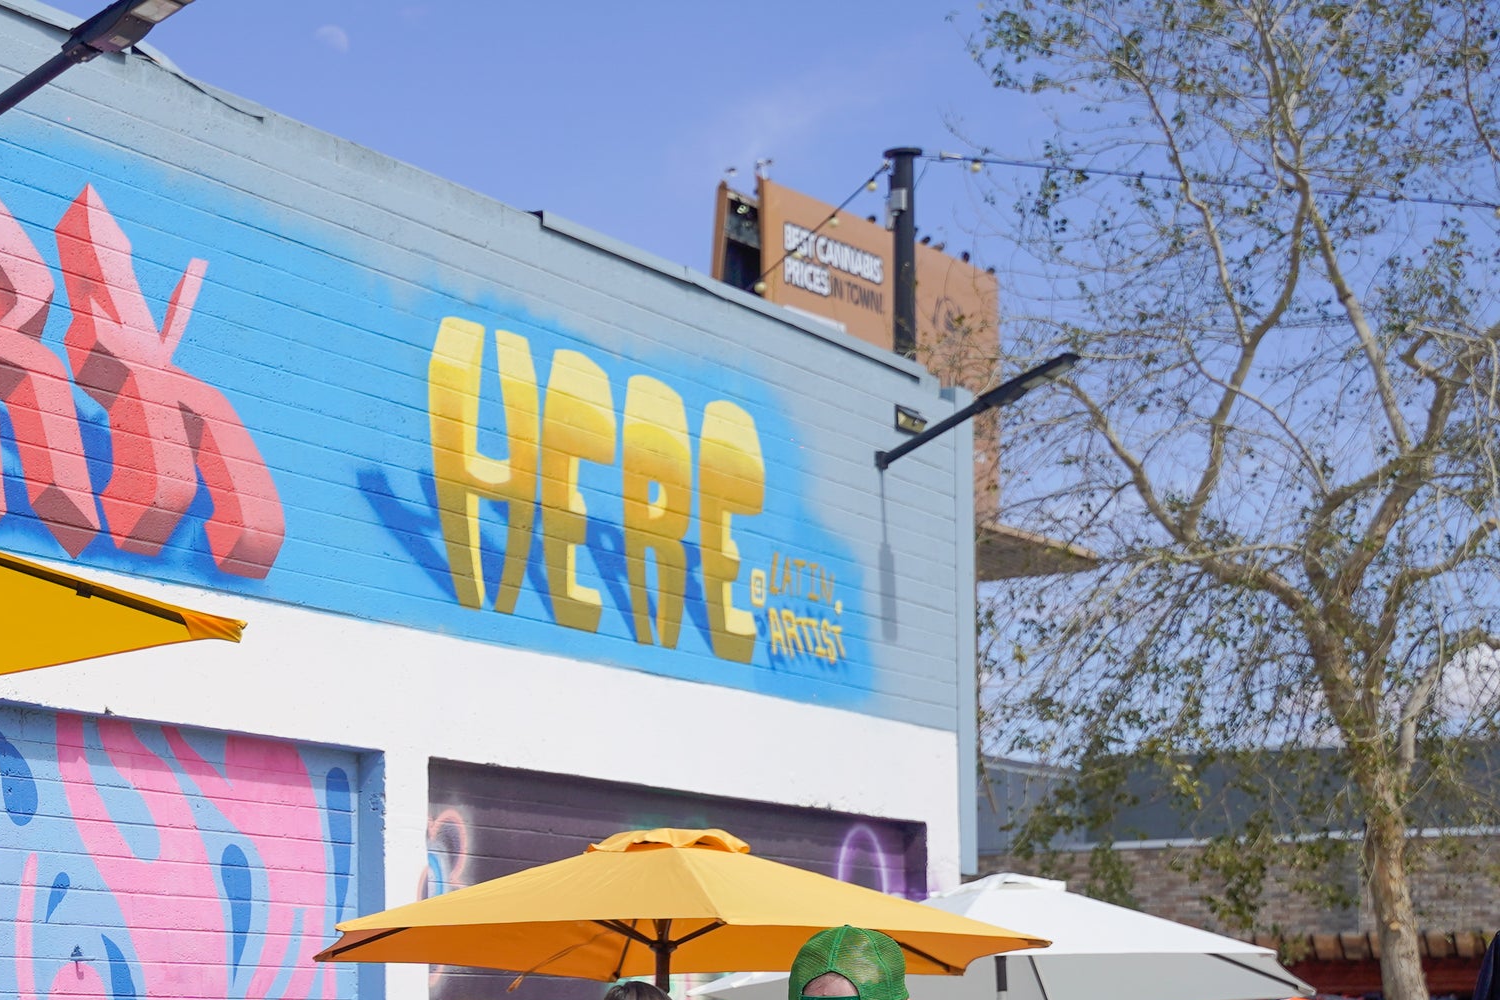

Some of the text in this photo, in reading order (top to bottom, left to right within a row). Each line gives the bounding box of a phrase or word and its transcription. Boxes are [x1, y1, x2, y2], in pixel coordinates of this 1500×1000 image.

[783, 222, 883, 285] BEST CANNABIS
[784, 256, 831, 297] PRICES
[428, 316, 765, 664] HERE
[768, 607, 846, 664] ARTIST
